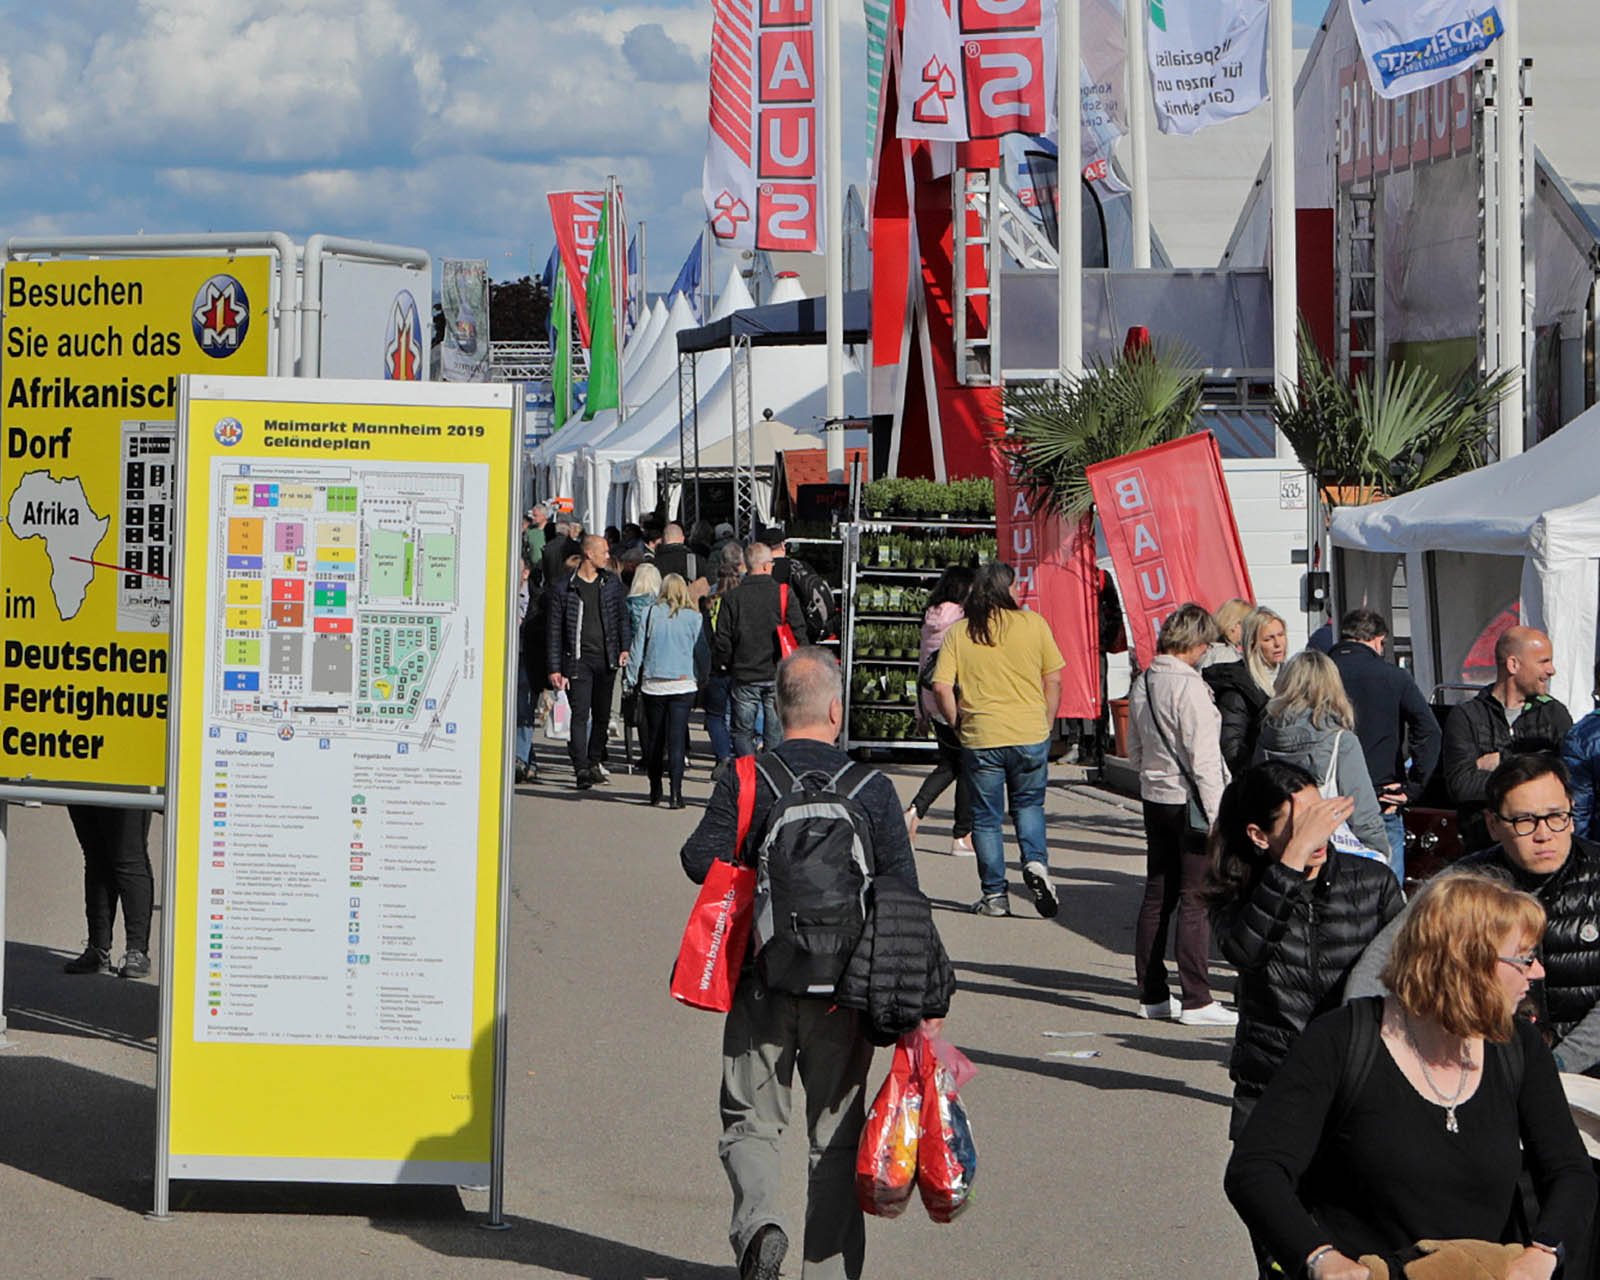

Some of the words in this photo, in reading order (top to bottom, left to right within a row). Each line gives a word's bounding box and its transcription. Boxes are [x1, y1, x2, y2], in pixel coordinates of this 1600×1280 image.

[8, 275, 143, 307] Besuchen
[7, 326, 50, 357] Sie
[57, 325, 124, 356] auch
[132, 324, 182, 356] das
[7, 427, 72, 459] Dorf
[264, 420, 347, 434] Maimarkt
[352, 422, 442, 436] Mannheim
[447, 425, 485, 437] 2019
[264, 435, 371, 451] Geländeplan
[23, 499, 81, 527] Afrika
[5, 588, 35, 619] im
[4, 638, 168, 673] Deutschen
[2, 726, 105, 760] Center
